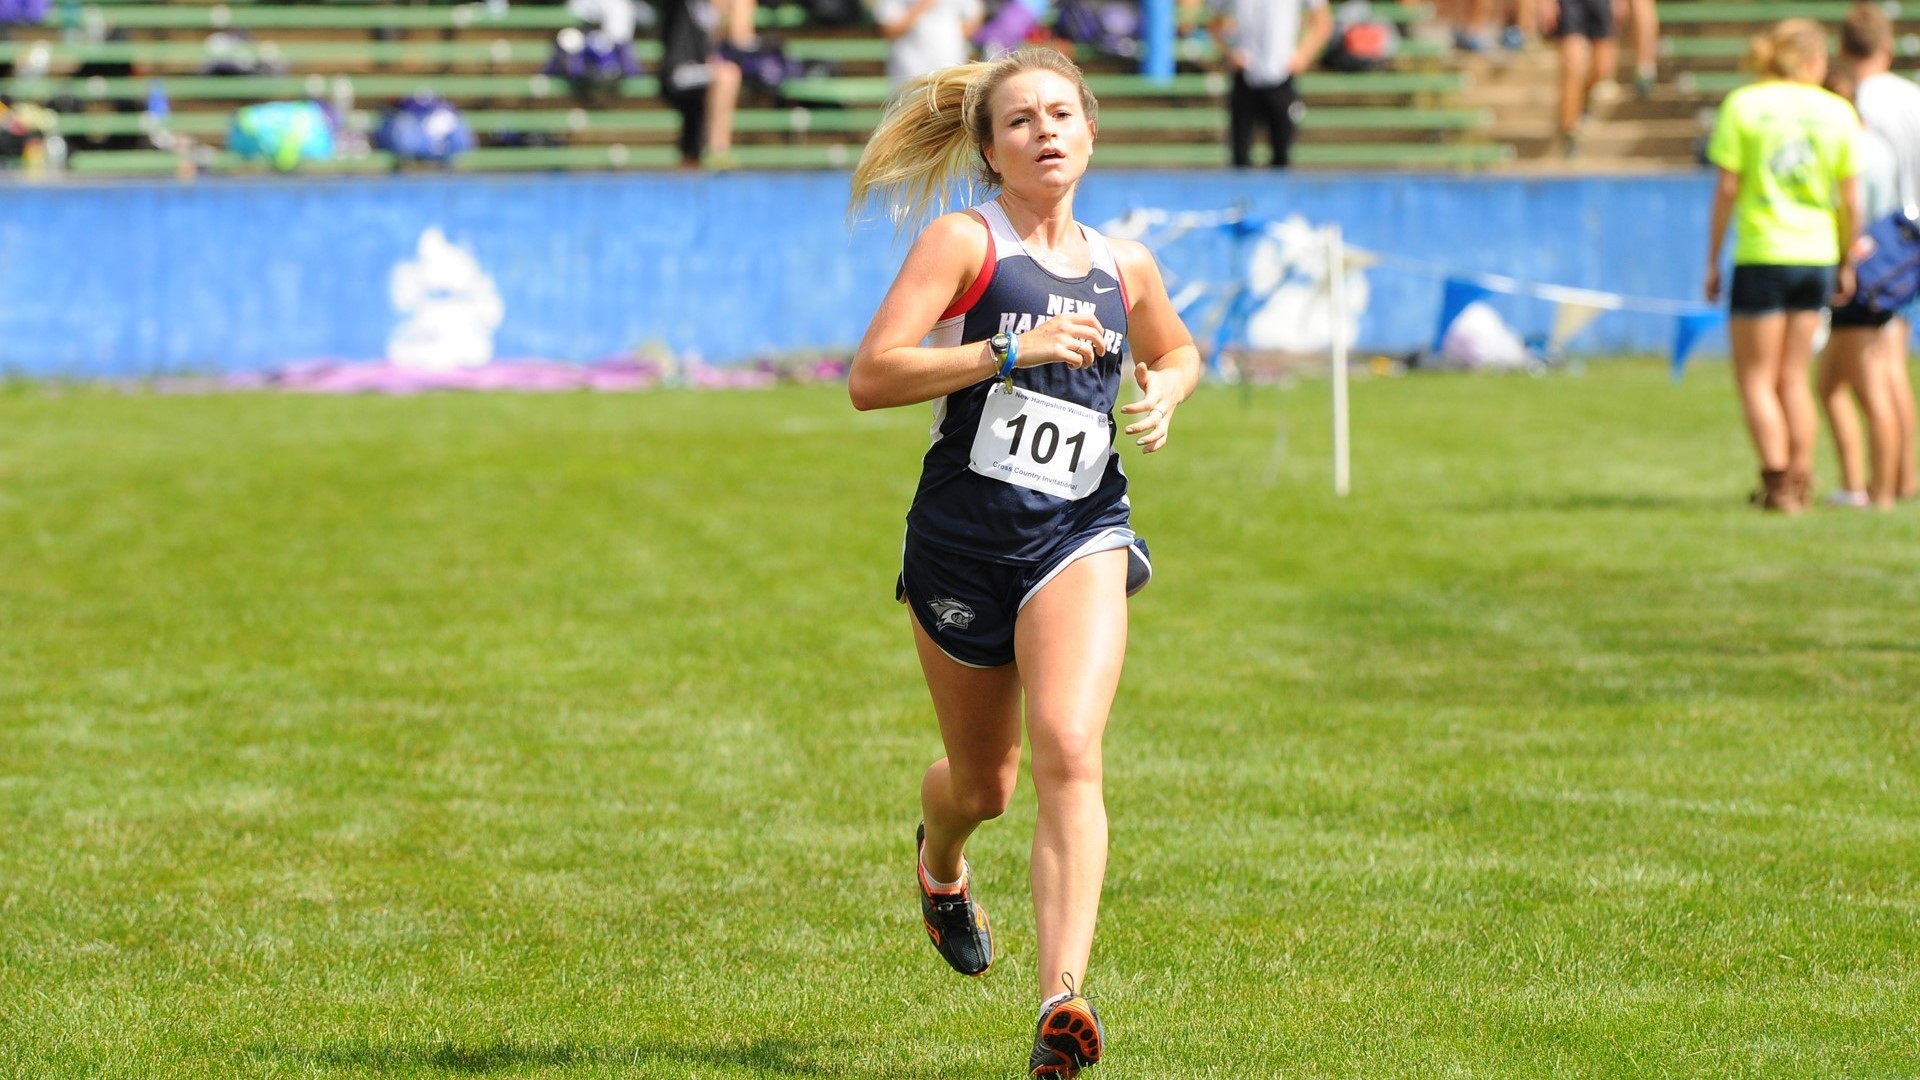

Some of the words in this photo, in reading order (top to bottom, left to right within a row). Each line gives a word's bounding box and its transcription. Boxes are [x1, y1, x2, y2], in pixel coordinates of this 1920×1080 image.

[1046, 293, 1097, 315] NEW
[1015, 391, 1029, 401] New
[1031, 396, 1067, 412] Hampshire
[1006, 414, 1087, 473] 101
[992, 461, 1013, 472] Cross
[1014, 467, 1041, 481] Country
[1042, 475, 1078, 490] Invitational
